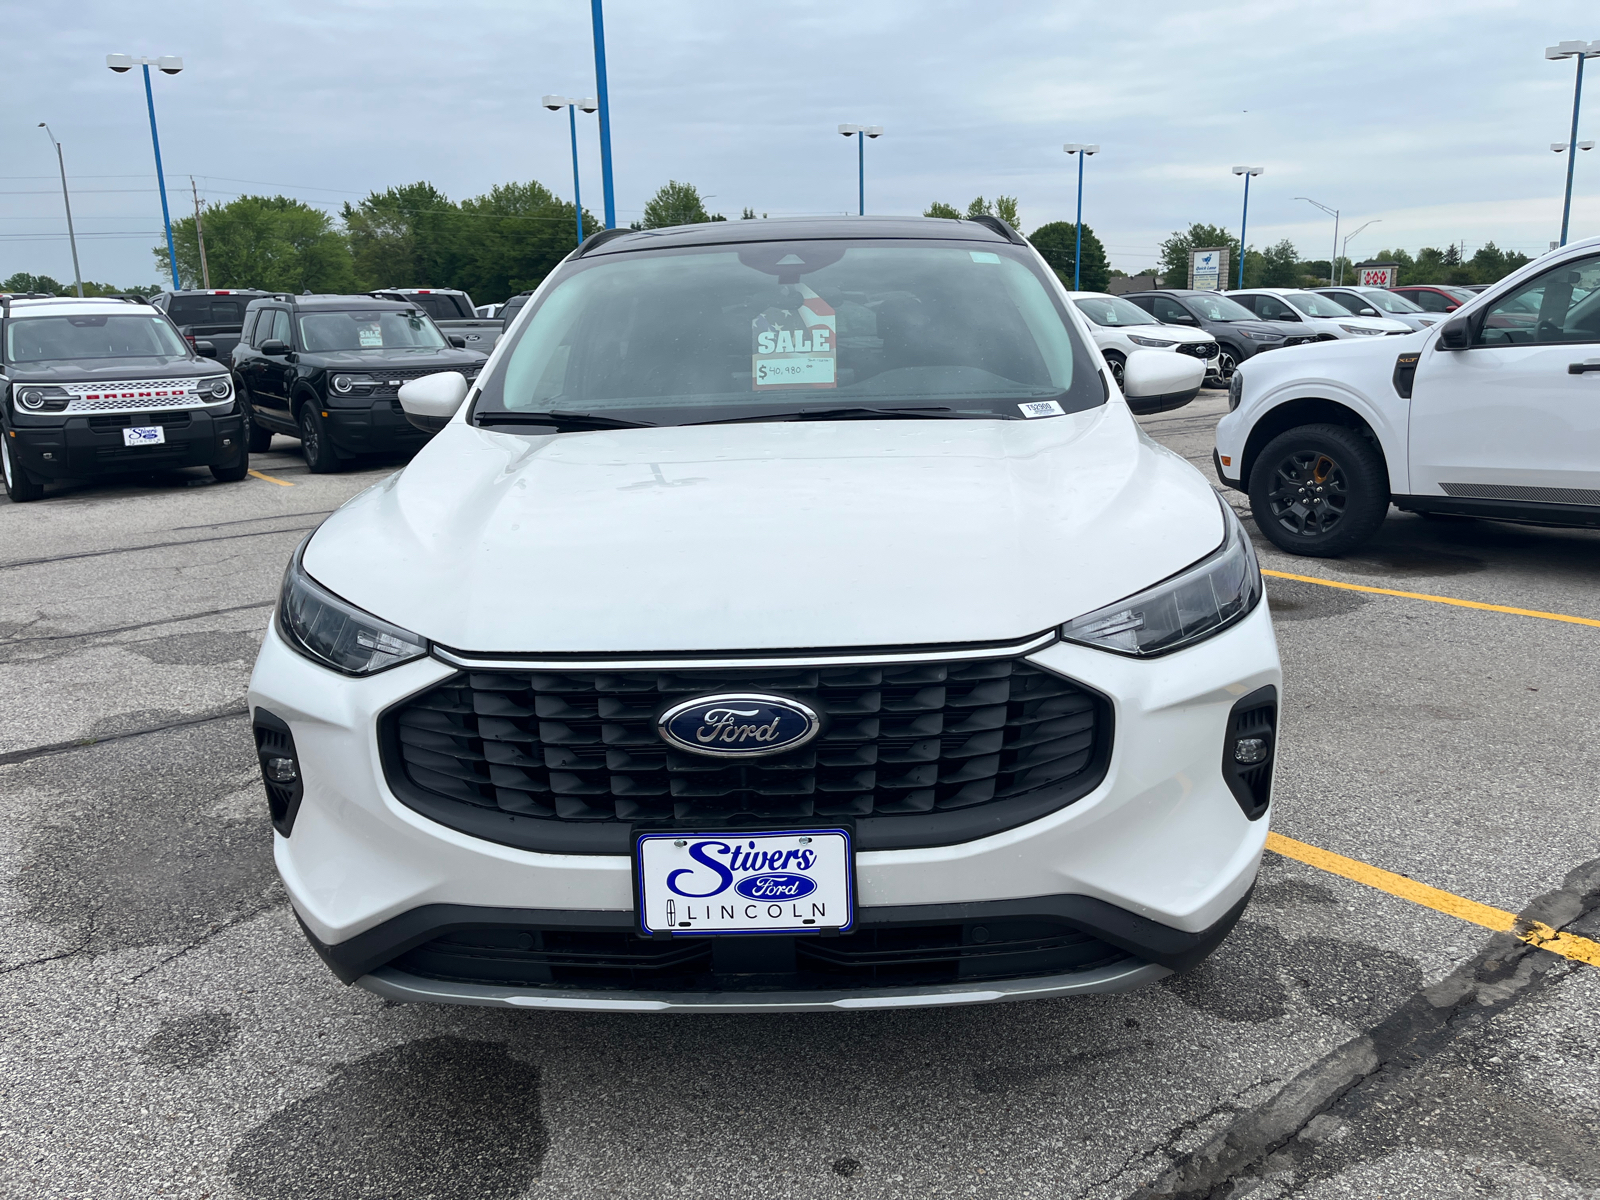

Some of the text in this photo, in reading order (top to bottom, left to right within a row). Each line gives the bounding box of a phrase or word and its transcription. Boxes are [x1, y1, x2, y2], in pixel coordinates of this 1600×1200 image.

[359, 330, 380, 338] SALE
[757, 329, 830, 354] SALE
[86, 390, 184, 399] BRONCO
[128, 428, 157, 439] Stivers
[696, 708, 781, 743] Ford
[666, 840, 818, 898] Stivers
[751, 876, 799, 897] Ford
[687, 902, 826, 920] LINCOLN
